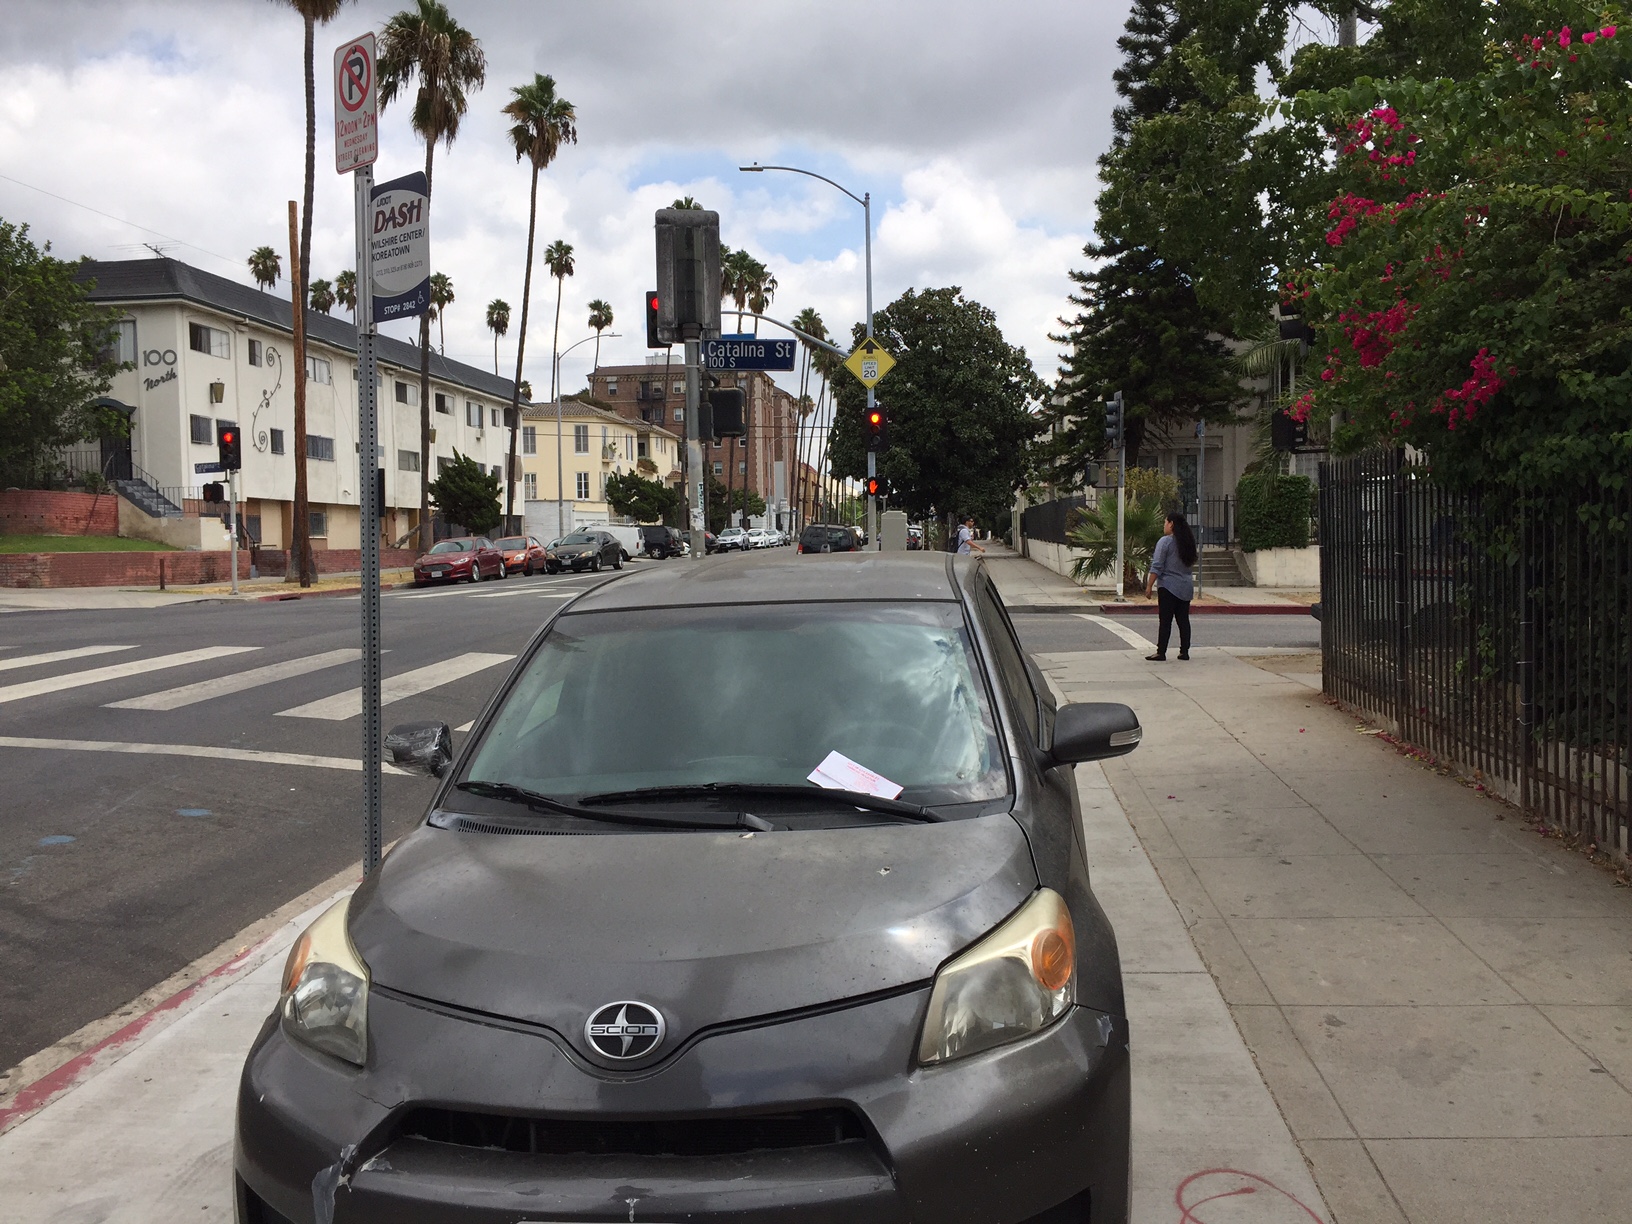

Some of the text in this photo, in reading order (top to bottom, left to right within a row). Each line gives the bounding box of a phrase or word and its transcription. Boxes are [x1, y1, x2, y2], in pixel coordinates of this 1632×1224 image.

[344, 132, 368, 148] WEDNESDAY
[338, 142, 374, 162] STREET CLEANING
[374, 198, 422, 234] DASH
[371, 228, 426, 250] WILSHIRE CENTER/
[372, 244, 410, 262] KOREATOWN
[384, 300, 416, 314] STOP# 2842
[143, 350, 177, 366] 100
[708, 342, 790, 358] Catalina St
[708, 357, 736, 368] 100 S
[144, 368, 177, 391] North
[590, 1026, 658, 1034] SCION
